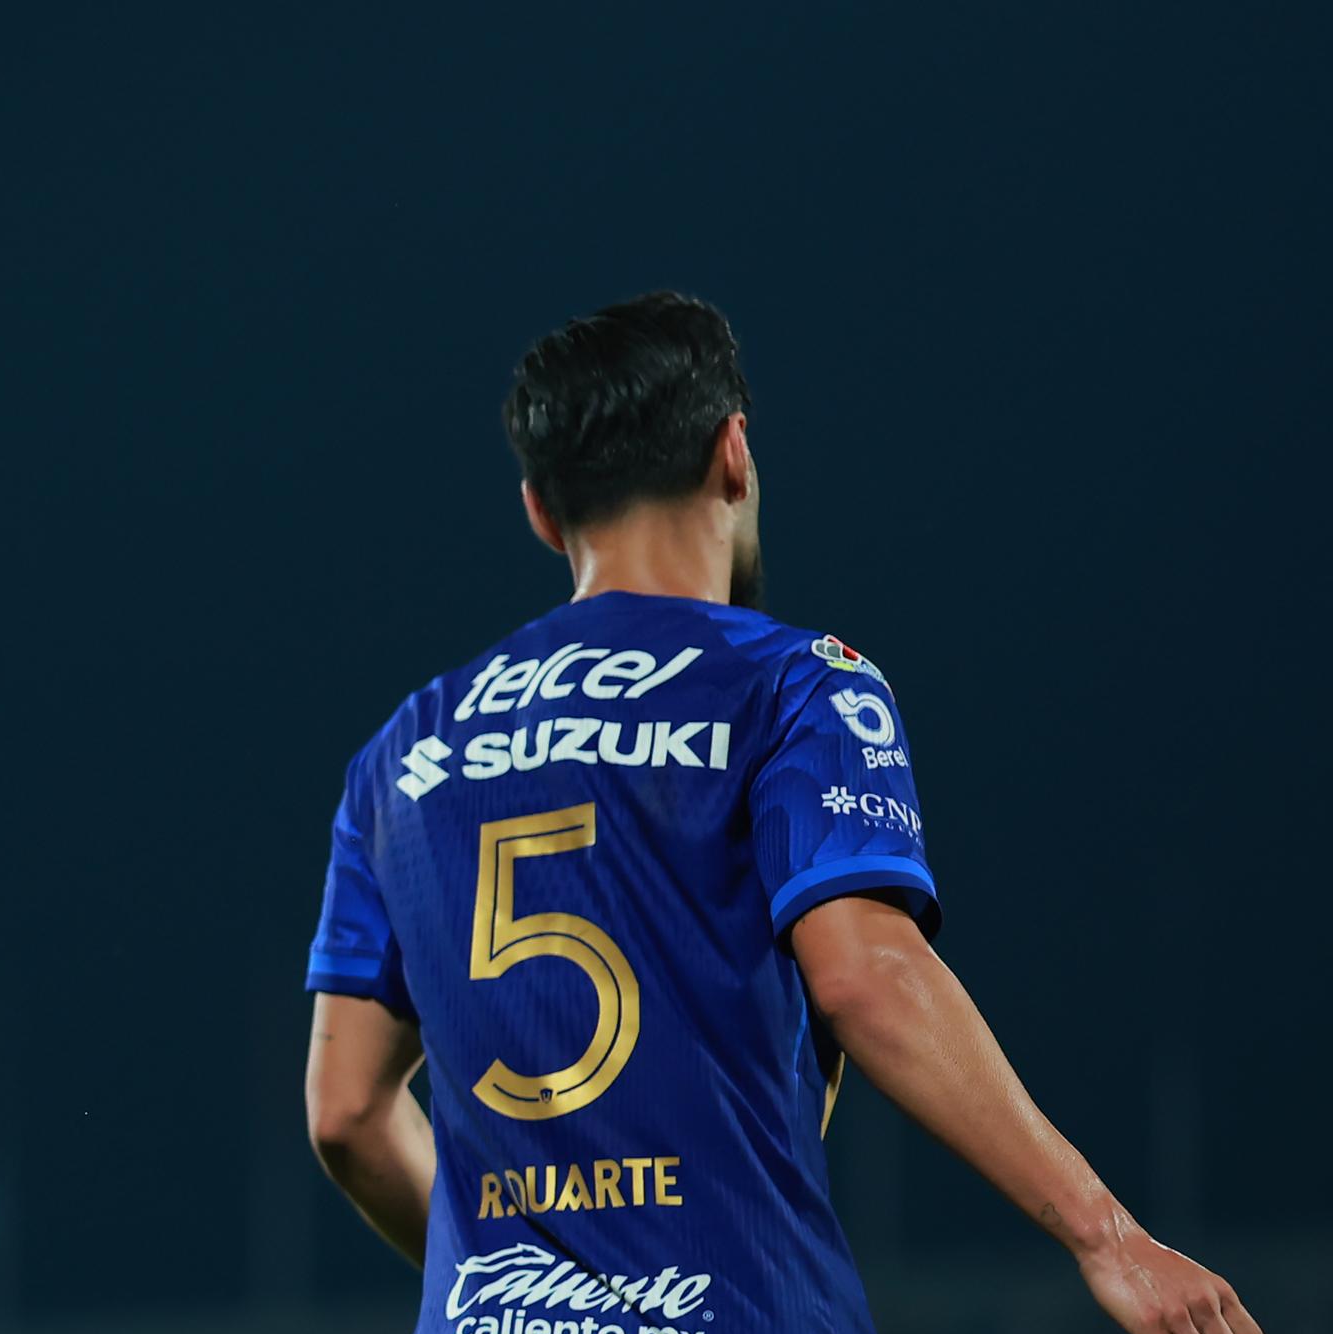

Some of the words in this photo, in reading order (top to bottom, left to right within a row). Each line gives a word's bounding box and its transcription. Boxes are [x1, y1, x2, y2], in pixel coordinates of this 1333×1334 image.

[453, 642, 704, 722] telcel
[461, 717, 731, 781] SUZUKI
[861, 746, 909, 770] Berel
[469, 802, 640, 1121] 5
[446, 1242, 712, 1320] Caliente
